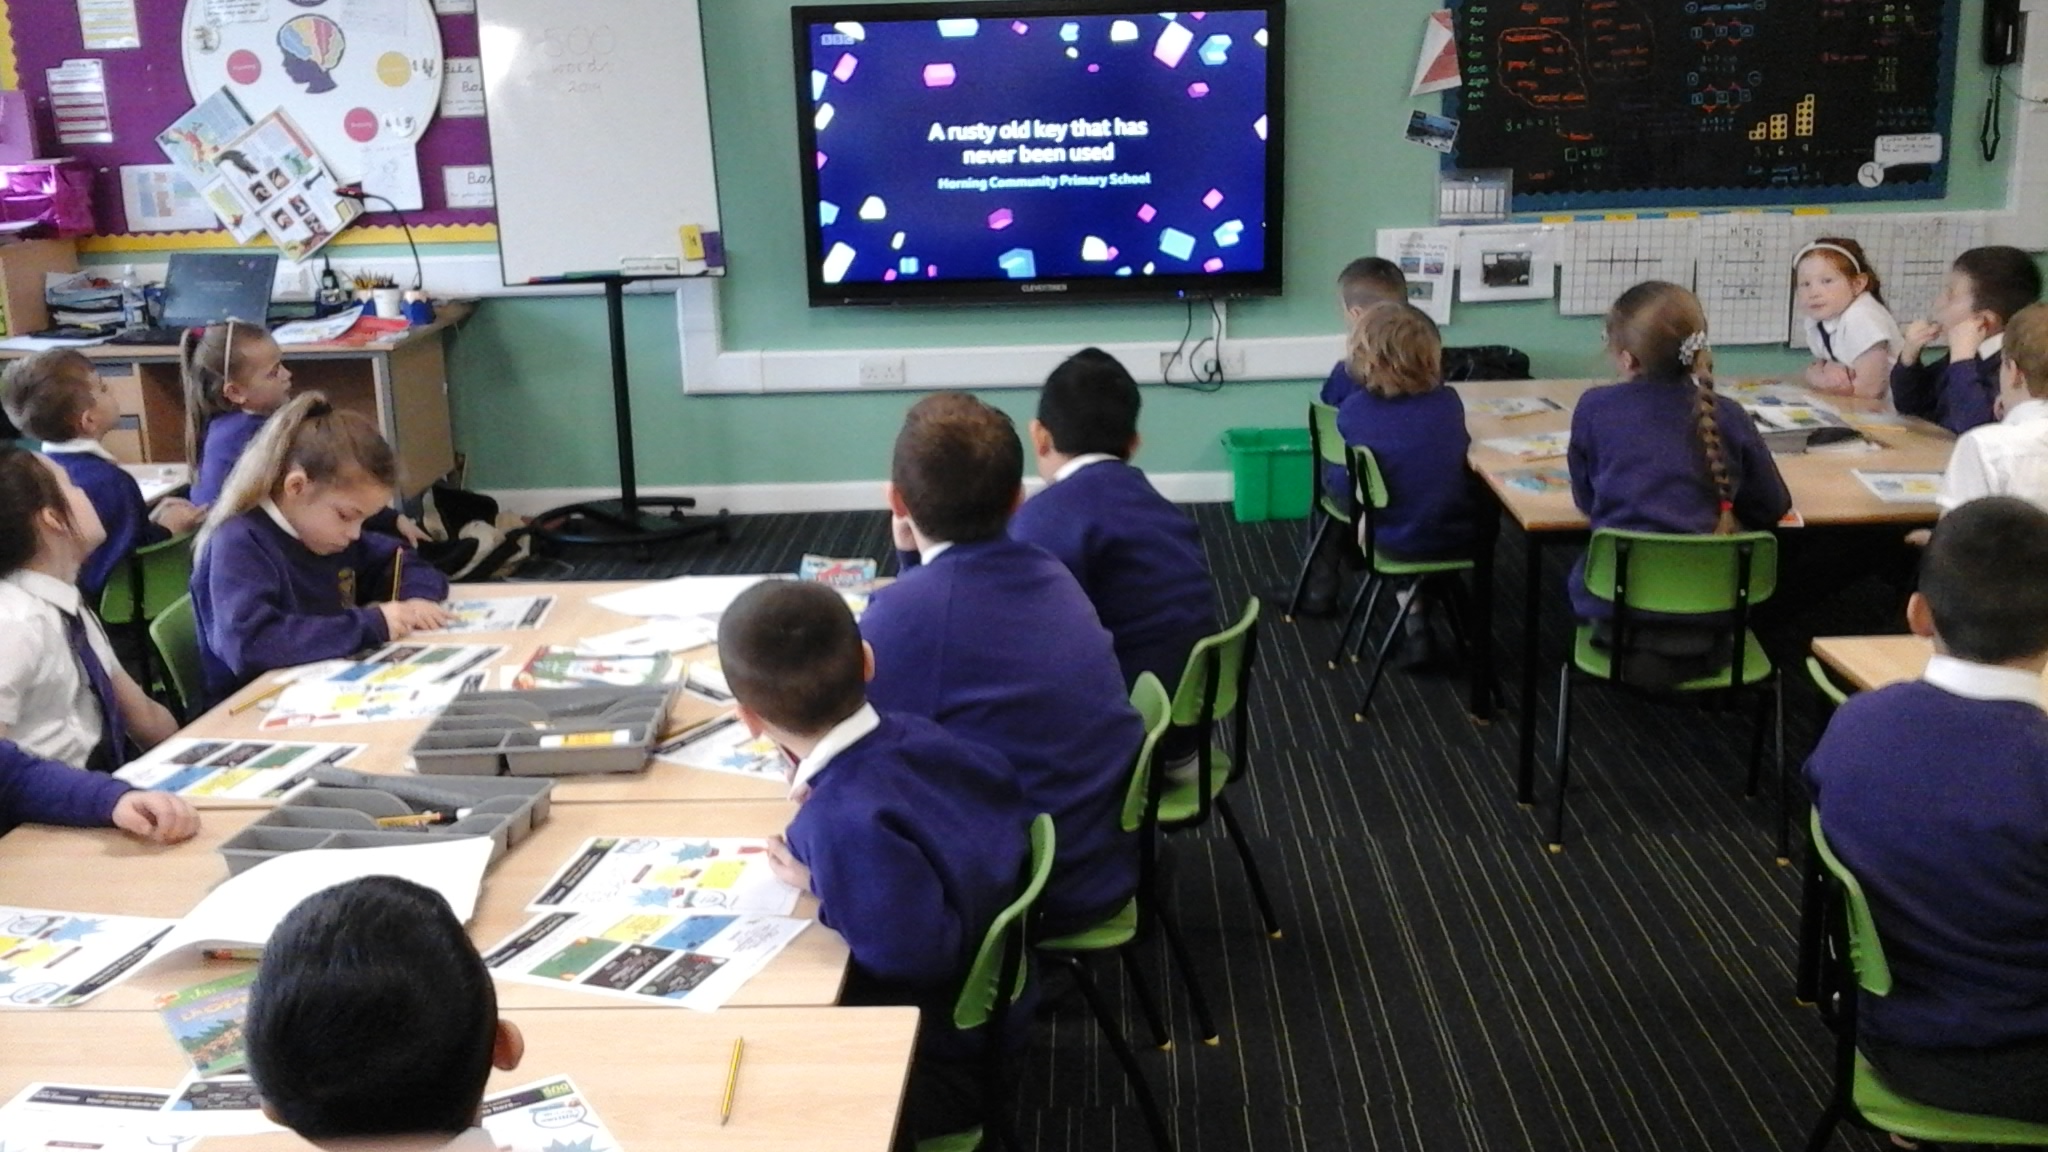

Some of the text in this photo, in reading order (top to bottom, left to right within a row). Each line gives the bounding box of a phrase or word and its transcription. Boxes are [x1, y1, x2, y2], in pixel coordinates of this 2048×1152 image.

[544, 25, 617, 58] 500
[821, 33, 855, 46] BBC
[928, 116, 1149, 144] A rusty old key that has
[962, 141, 1116, 165] never been used
[937, 171, 1151, 191] Horning Community Primary School
